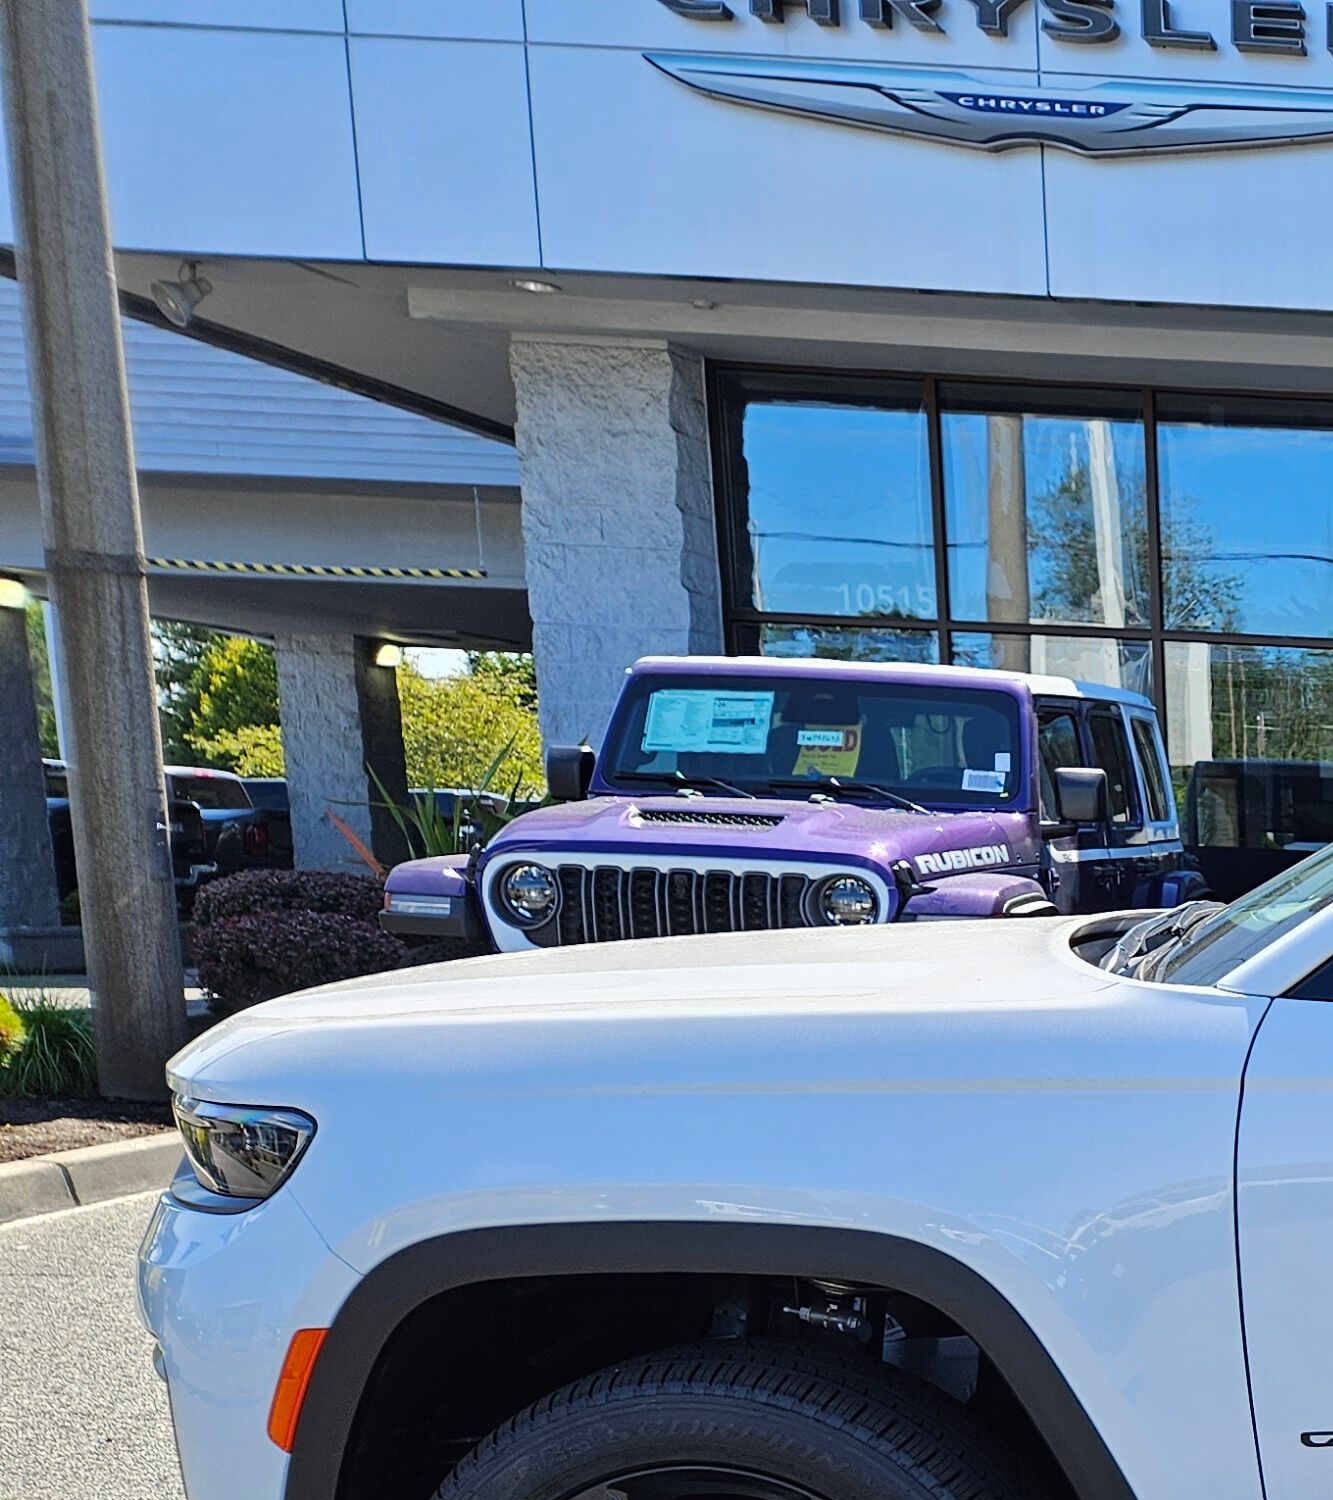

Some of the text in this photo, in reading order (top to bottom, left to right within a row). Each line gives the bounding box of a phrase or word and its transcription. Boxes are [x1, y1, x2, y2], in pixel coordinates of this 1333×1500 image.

[958, 96, 1106, 116] CHRYSLER
[839, 581, 933, 617] 10515
[914, 844, 1010, 875] RUBICON
